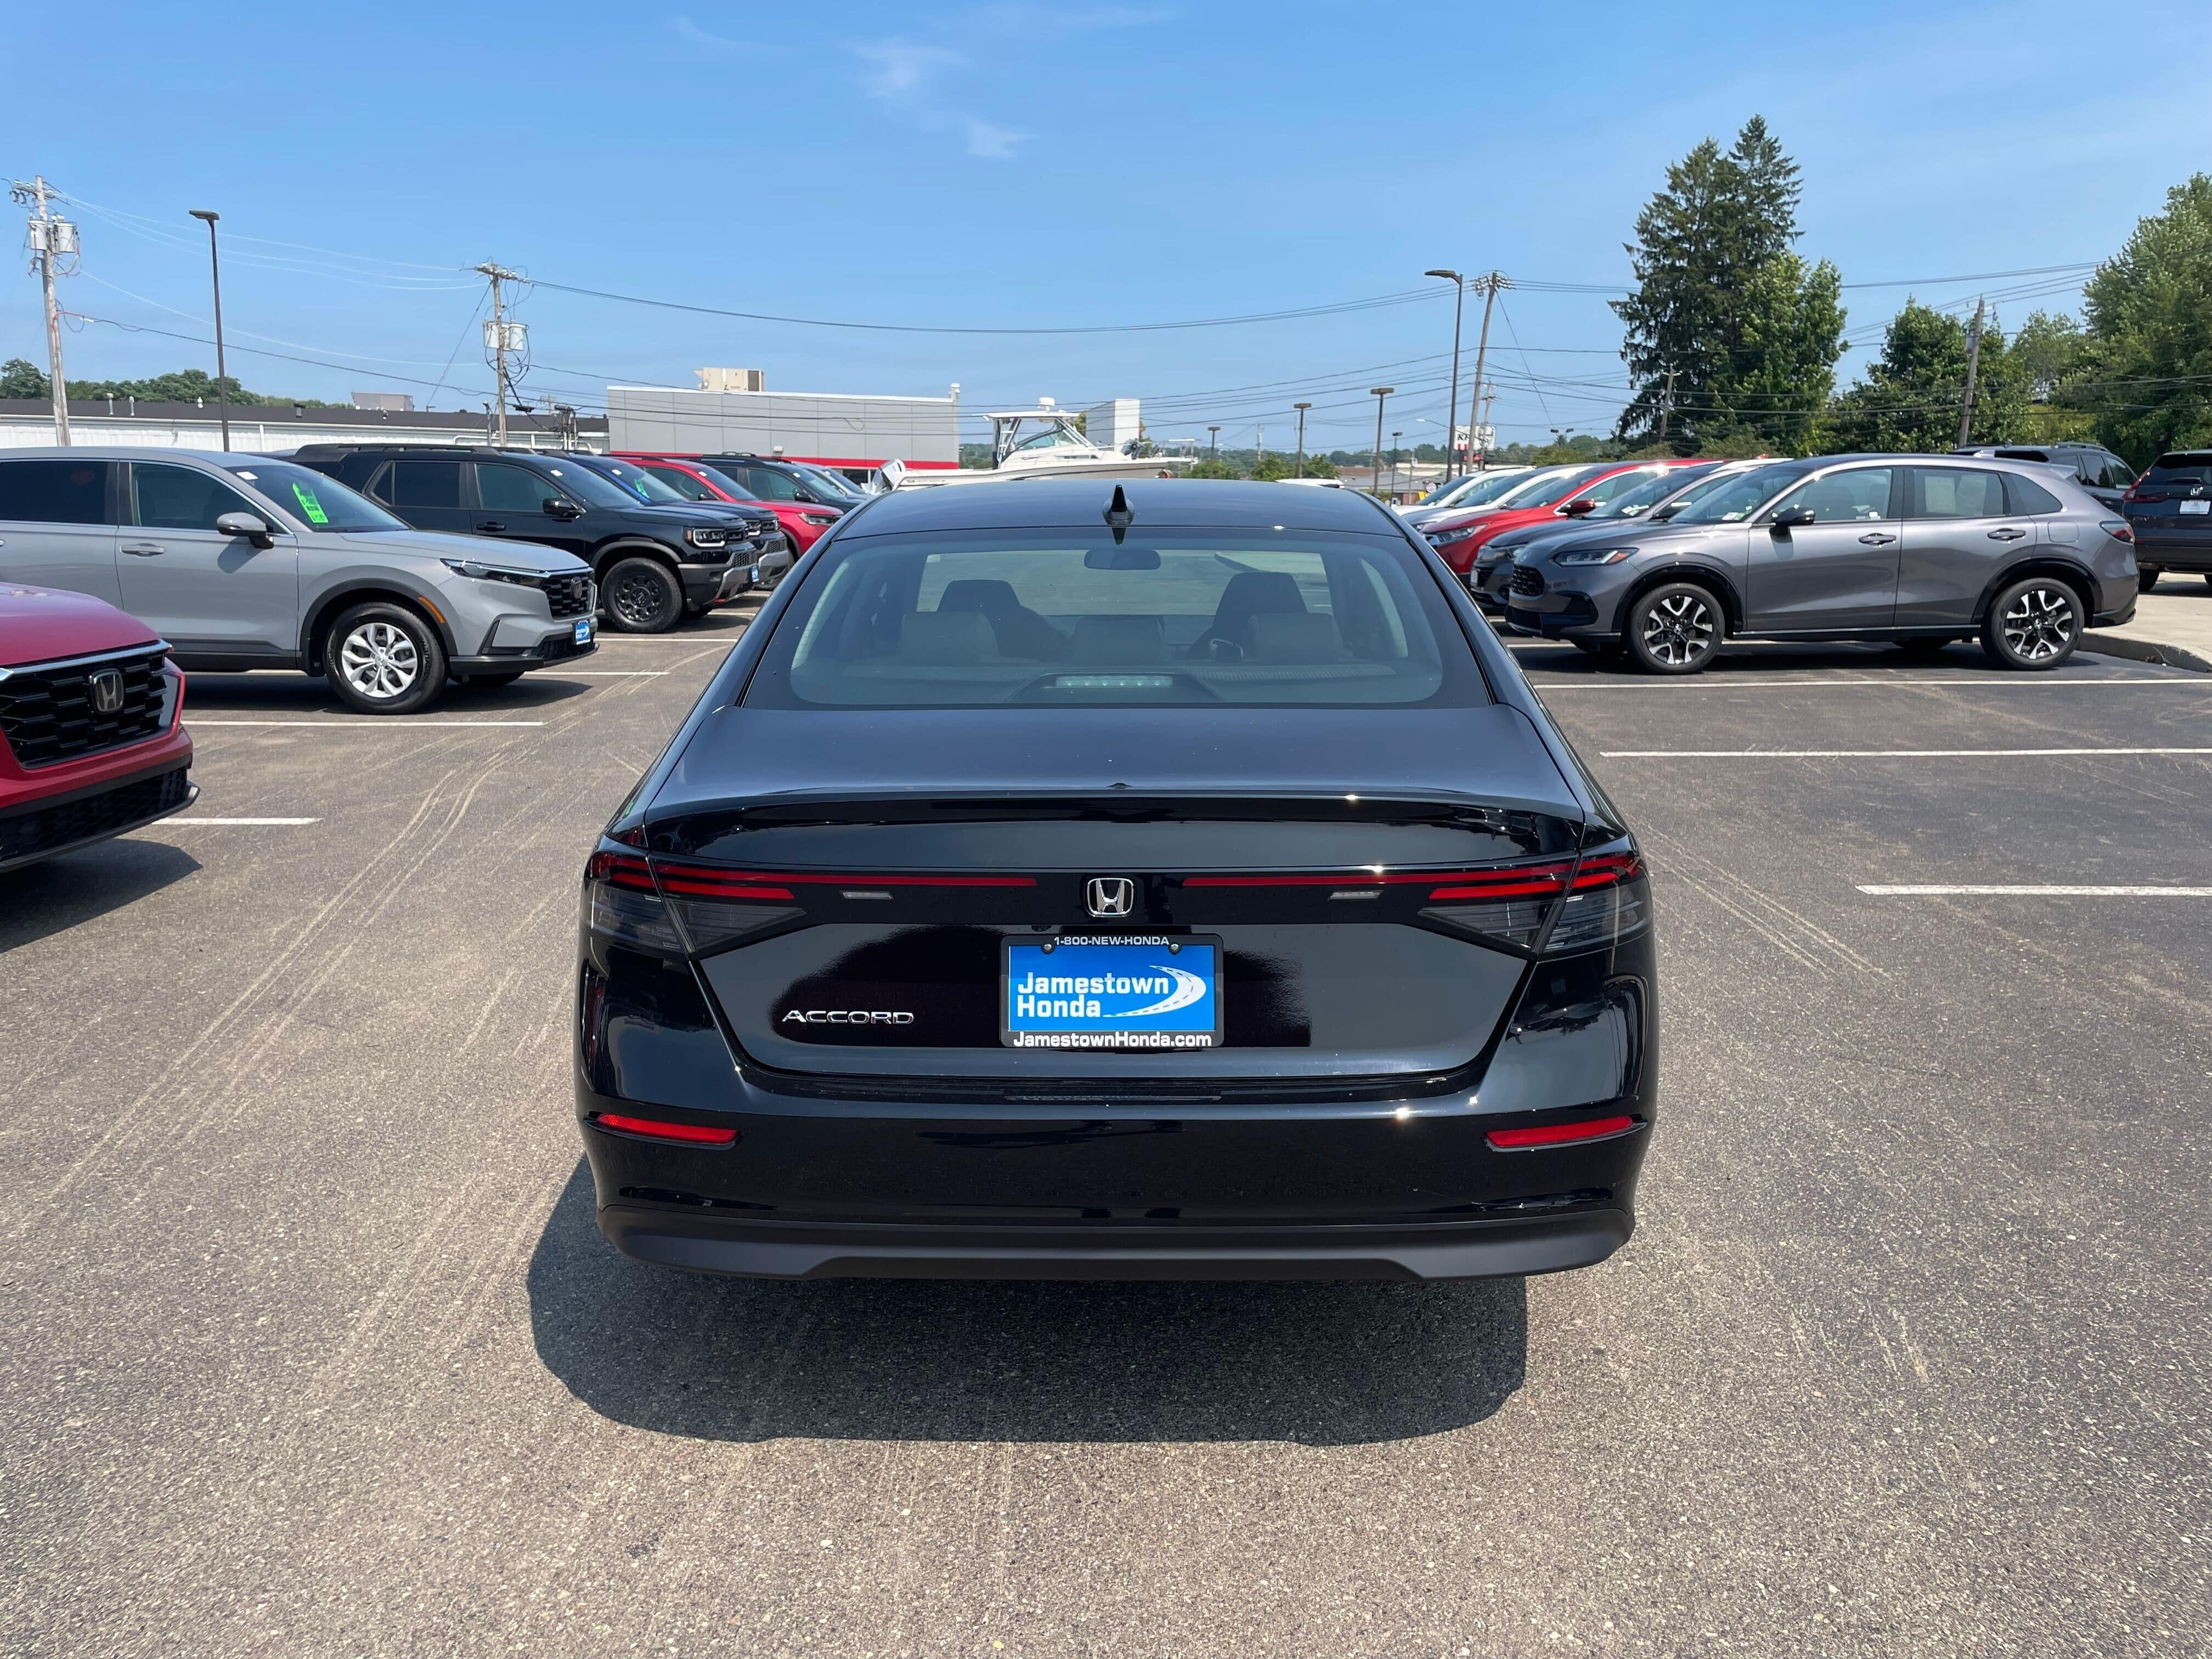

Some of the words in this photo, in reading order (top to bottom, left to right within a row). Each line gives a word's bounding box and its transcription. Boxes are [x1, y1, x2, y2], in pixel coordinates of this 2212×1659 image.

[1054, 936, 1169, 945] 1-800-NEW-HONDA
[1018, 972, 1169, 994] Jamestown
[1018, 995, 1101, 1017] Honda
[782, 1010, 914, 1024] ACCORD
[1013, 1031, 1211, 1046] JamestownHonda.com
